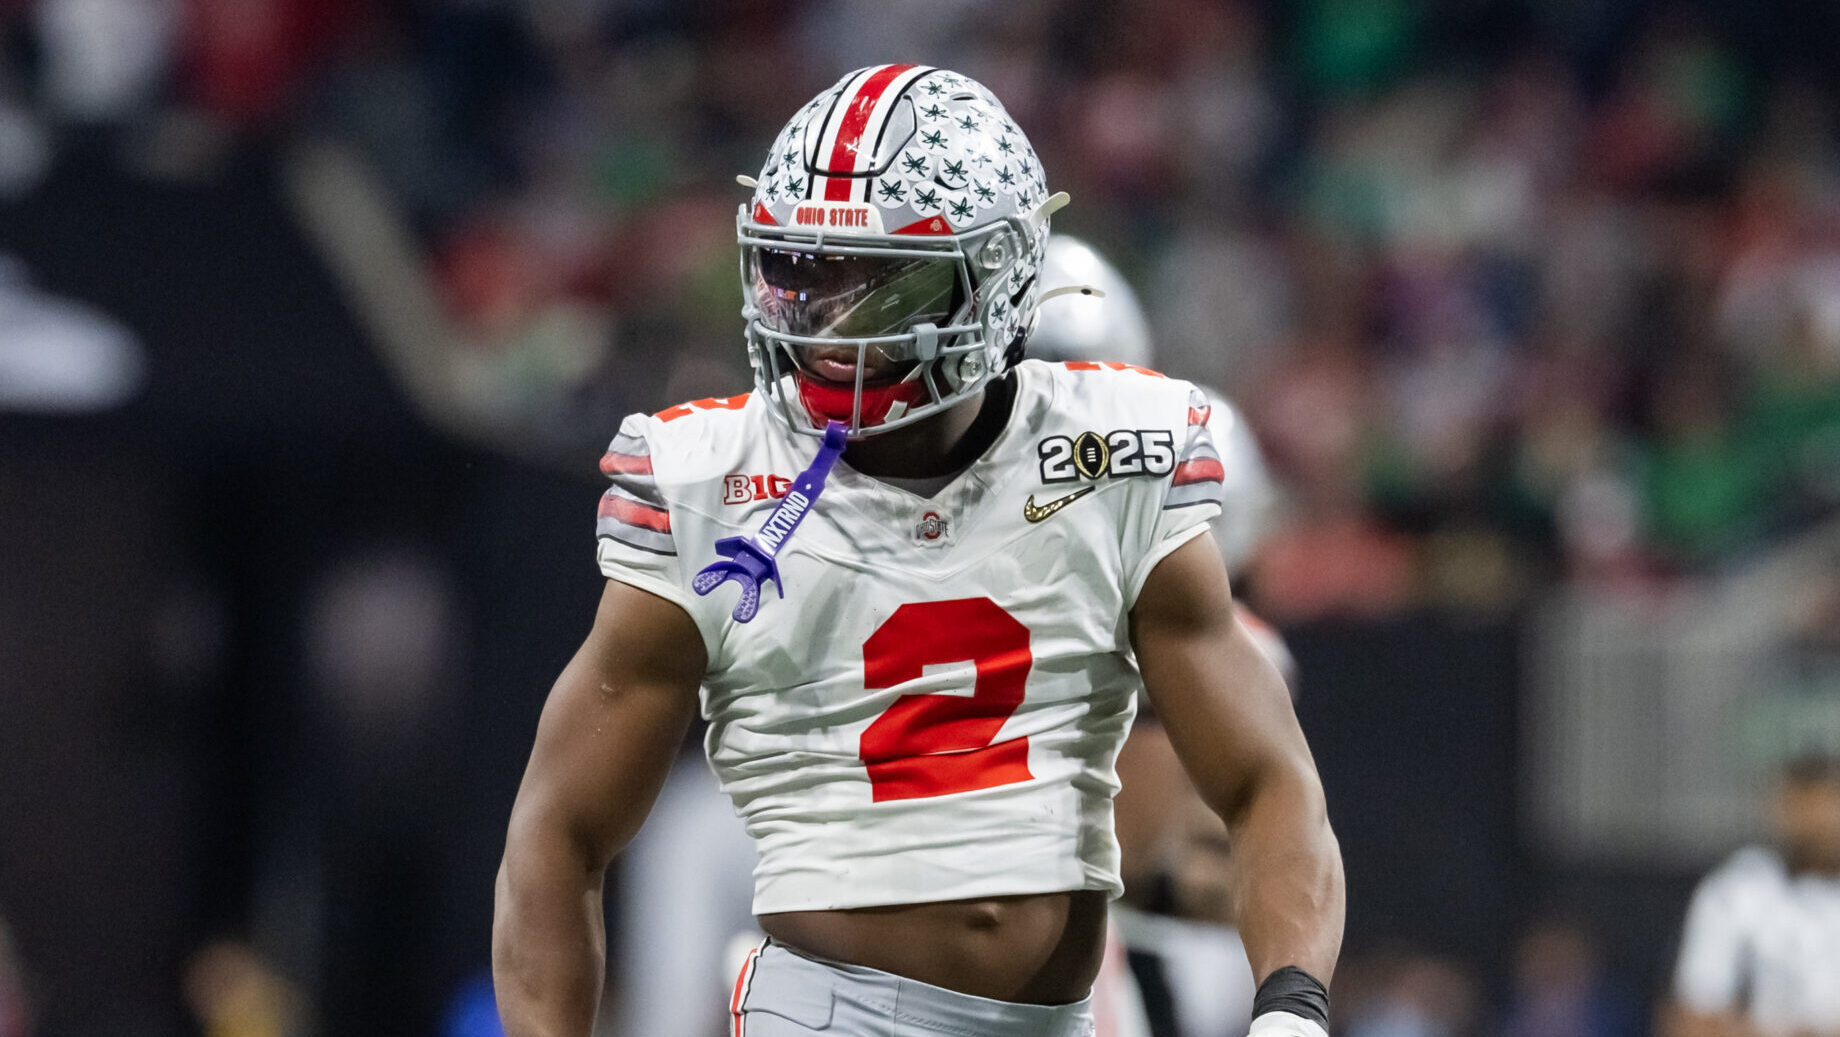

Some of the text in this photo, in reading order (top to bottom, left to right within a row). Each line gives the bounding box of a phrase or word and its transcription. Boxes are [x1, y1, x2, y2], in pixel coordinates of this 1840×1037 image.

[796, 206, 868, 227] OHIO STATE
[1038, 429, 1176, 485] 2025
[759, 491, 810, 548] NXTRND
[859, 596, 1036, 803] 2
